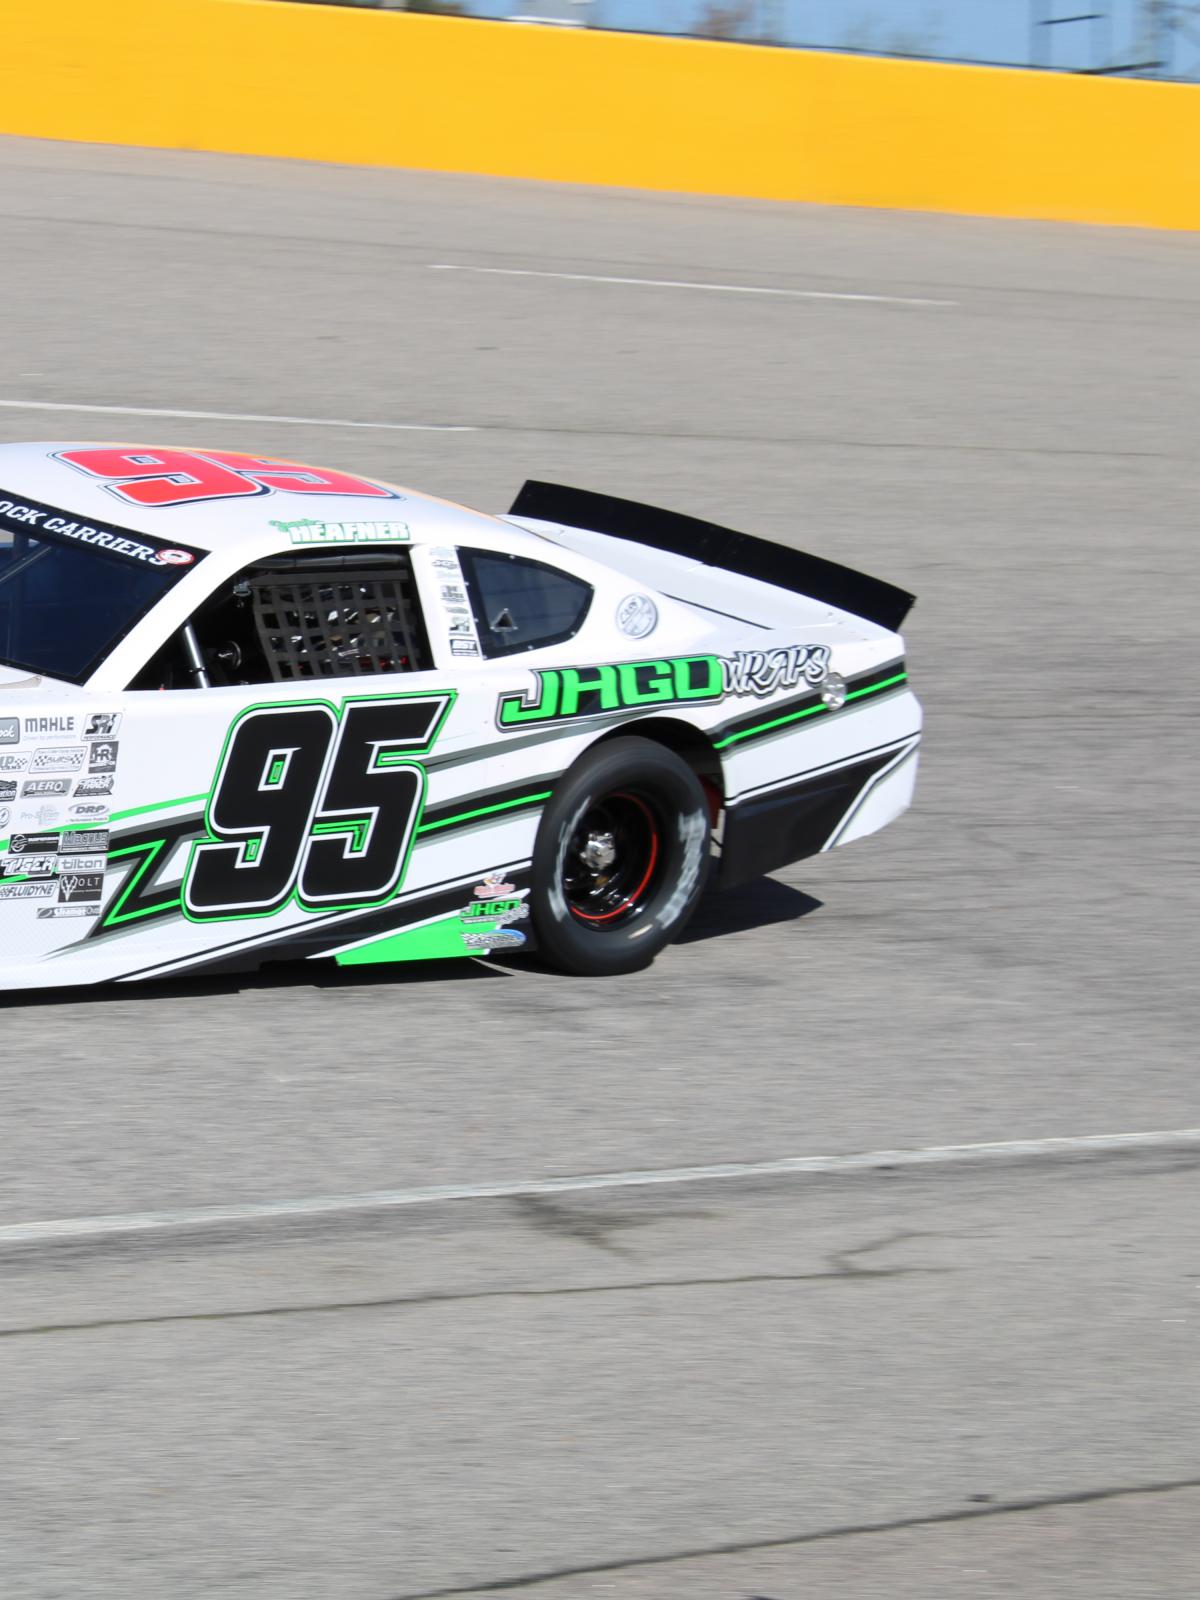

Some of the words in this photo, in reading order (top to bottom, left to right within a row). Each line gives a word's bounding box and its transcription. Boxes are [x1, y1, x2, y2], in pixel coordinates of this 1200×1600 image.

[46, 448, 405, 508] 95
[288, 521, 411, 544] HEAFNER
[25, 716, 75, 732] MAHLE
[27, 780, 64, 792] AERO
[75, 805, 106, 814] DRP
[181, 688, 457, 922] 95
[61, 859, 102, 870] tilton
[6, 884, 54, 898] FLUIDYNE
[60, 876, 100, 901] VOLT
